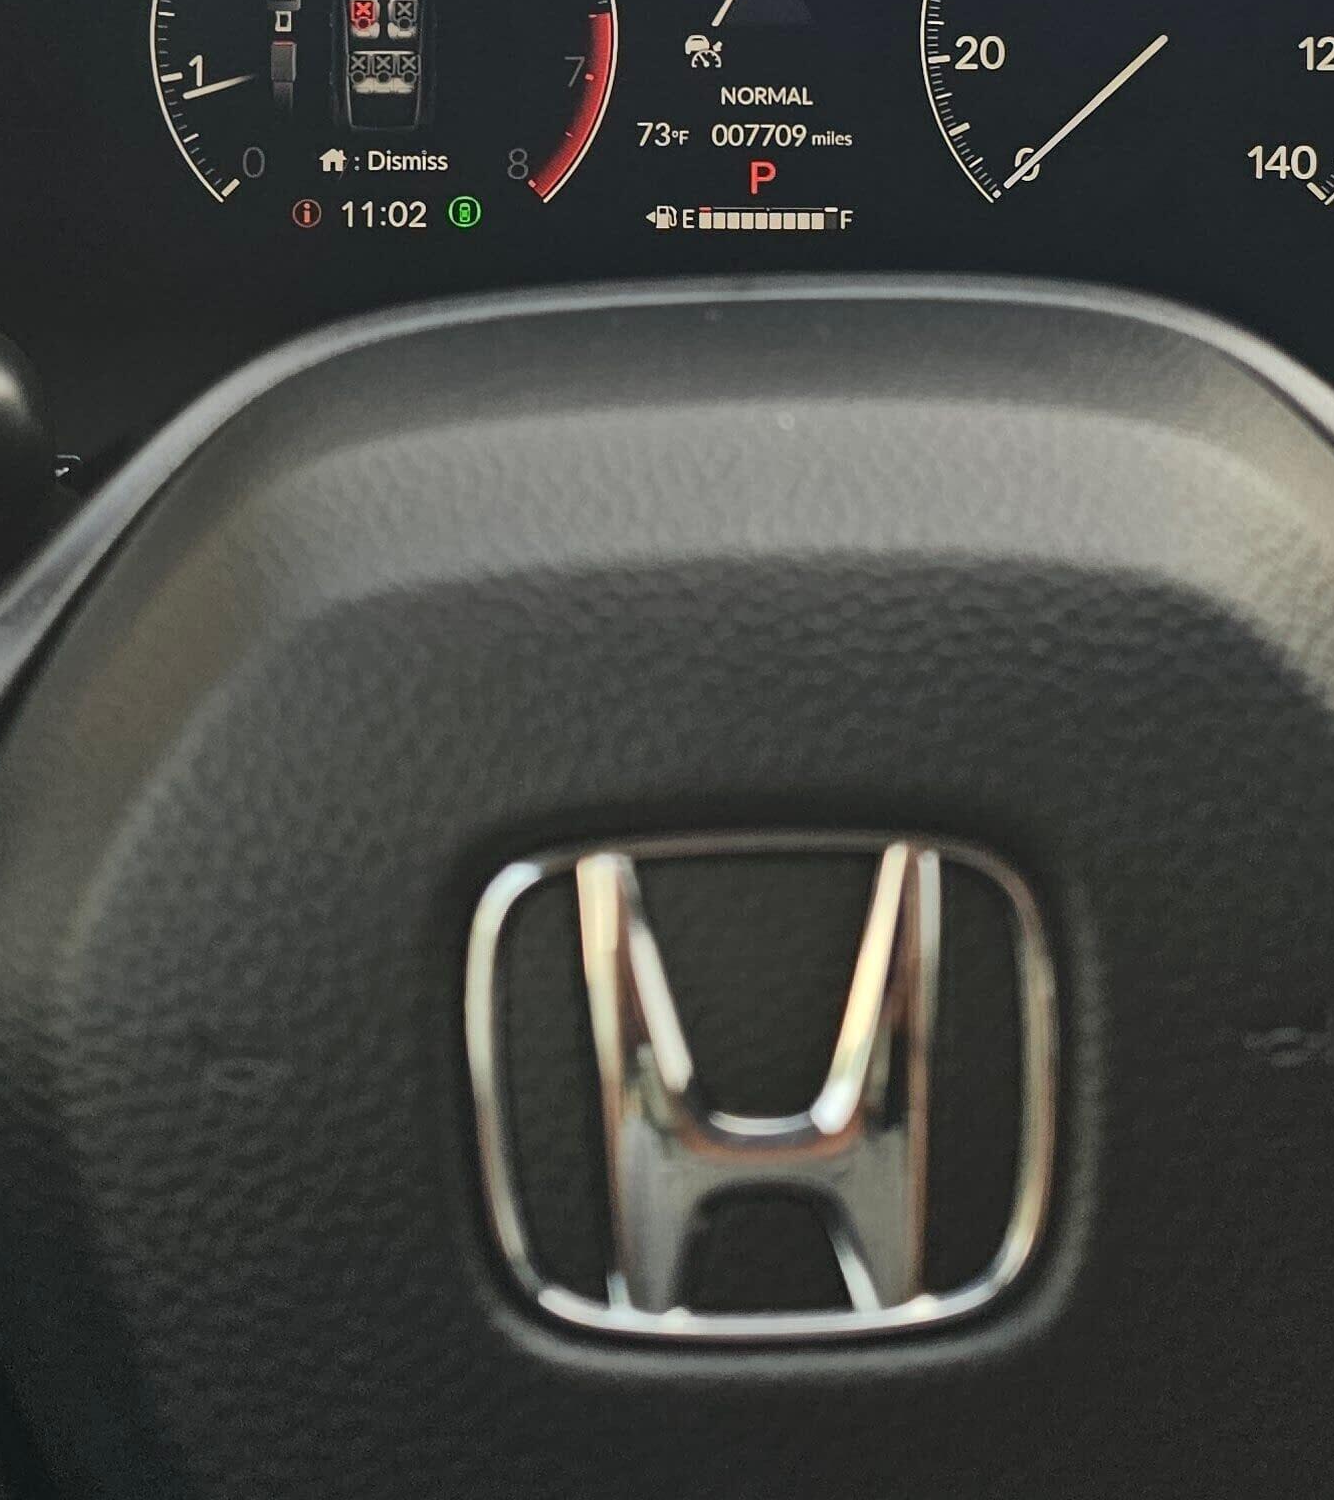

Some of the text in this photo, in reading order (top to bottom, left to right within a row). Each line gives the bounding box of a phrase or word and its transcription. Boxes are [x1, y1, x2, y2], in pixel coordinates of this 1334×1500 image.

[955, 36, 1005, 69] 20
[188, 55, 203, 87] 1
[567, 57, 585, 87] 7
[721, 87, 813, 105] NORMAL
[712, 124, 852, 146] 007709 miles
[243, 147, 265, 178] 0
[367, 148, 449, 172] Dismiss
[507, 148, 528, 179] 8
[1248, 146, 1316, 179] 140
[751, 162, 775, 194] P
[342, 201, 426, 227] 11:02
[683, 209, 694, 228] E
[841, 210, 853, 229] F
